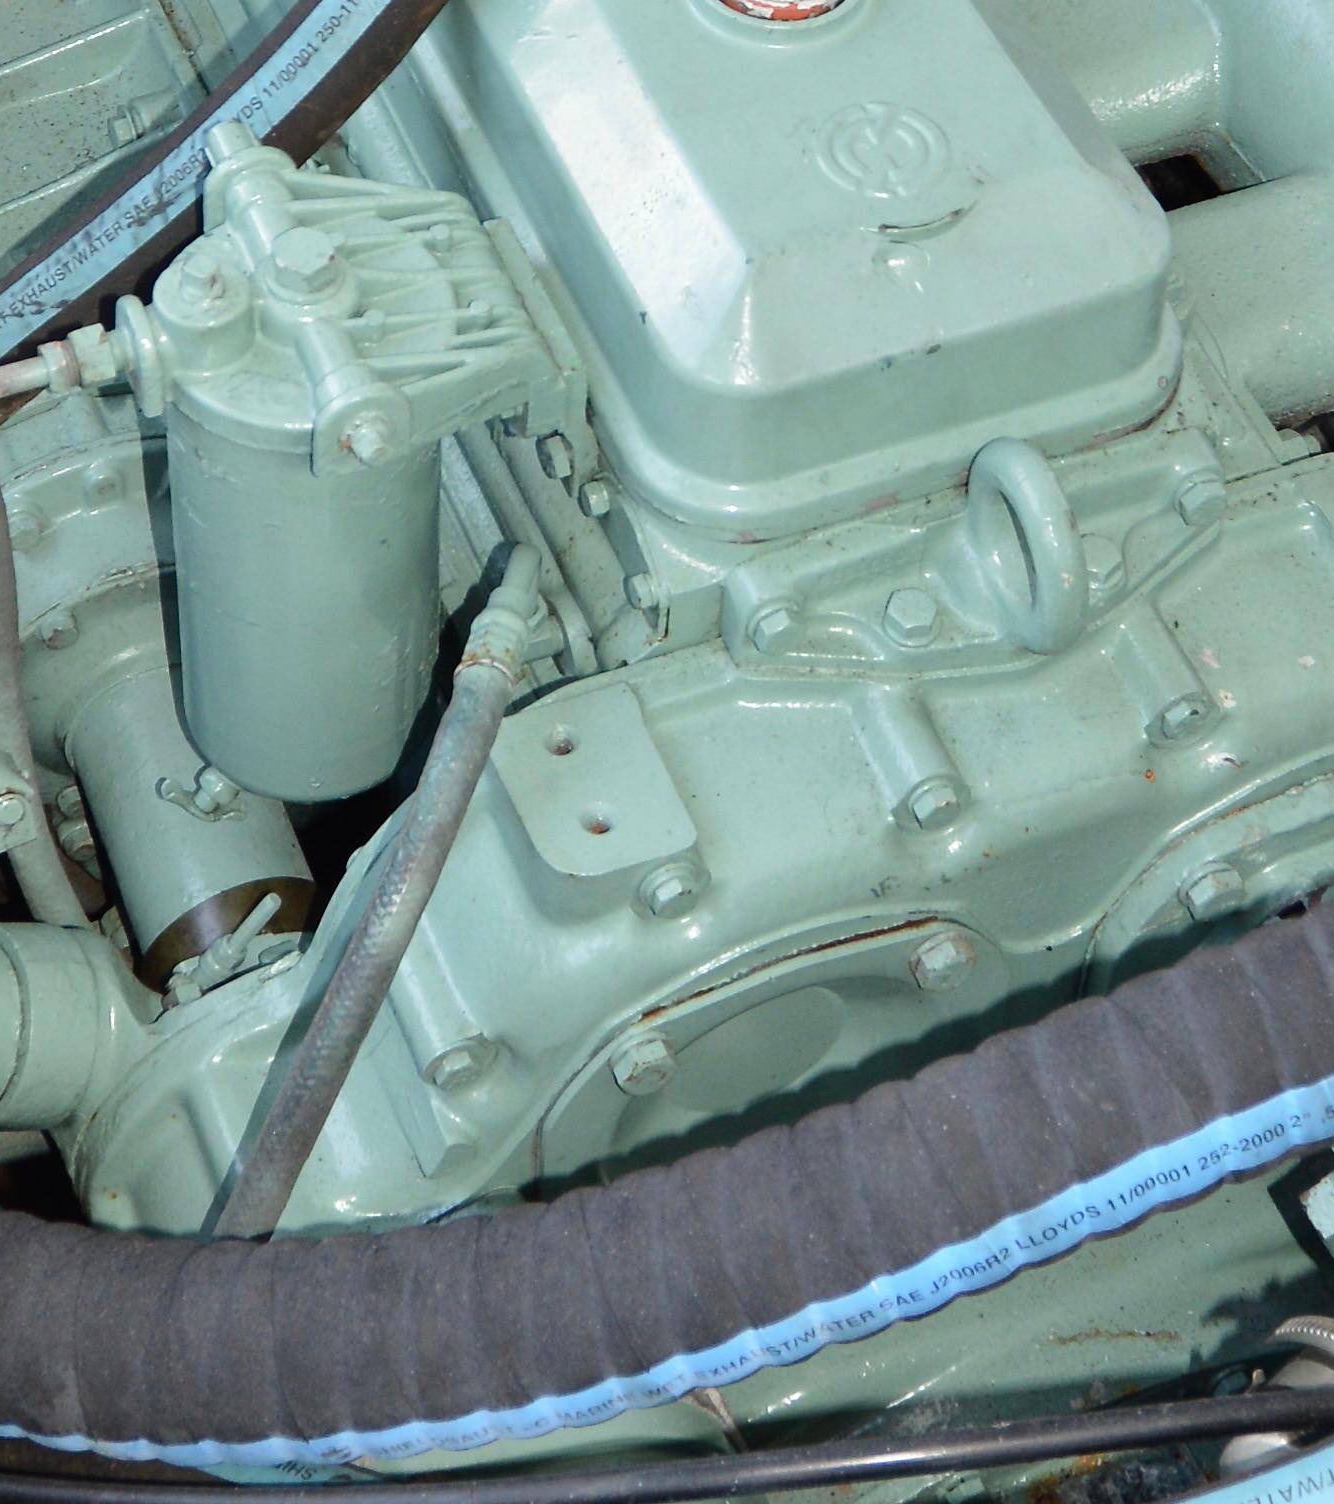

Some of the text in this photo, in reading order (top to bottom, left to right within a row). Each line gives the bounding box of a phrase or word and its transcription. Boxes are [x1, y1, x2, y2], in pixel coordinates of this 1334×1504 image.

[123, 194, 156, 222] SAE
[231, 95, 264, 126] YDS
[262, 39, 320, 99] 11/00001
[878, 1289, 924, 1311] SAE
[929, 1246, 1011, 1295] J2006R2
[1014, 1204, 1101, 1251] LLOYDS
[1107, 1163, 1191, 1212] 11/00001
[1197, 1122, 1285, 1173] 252-2000
